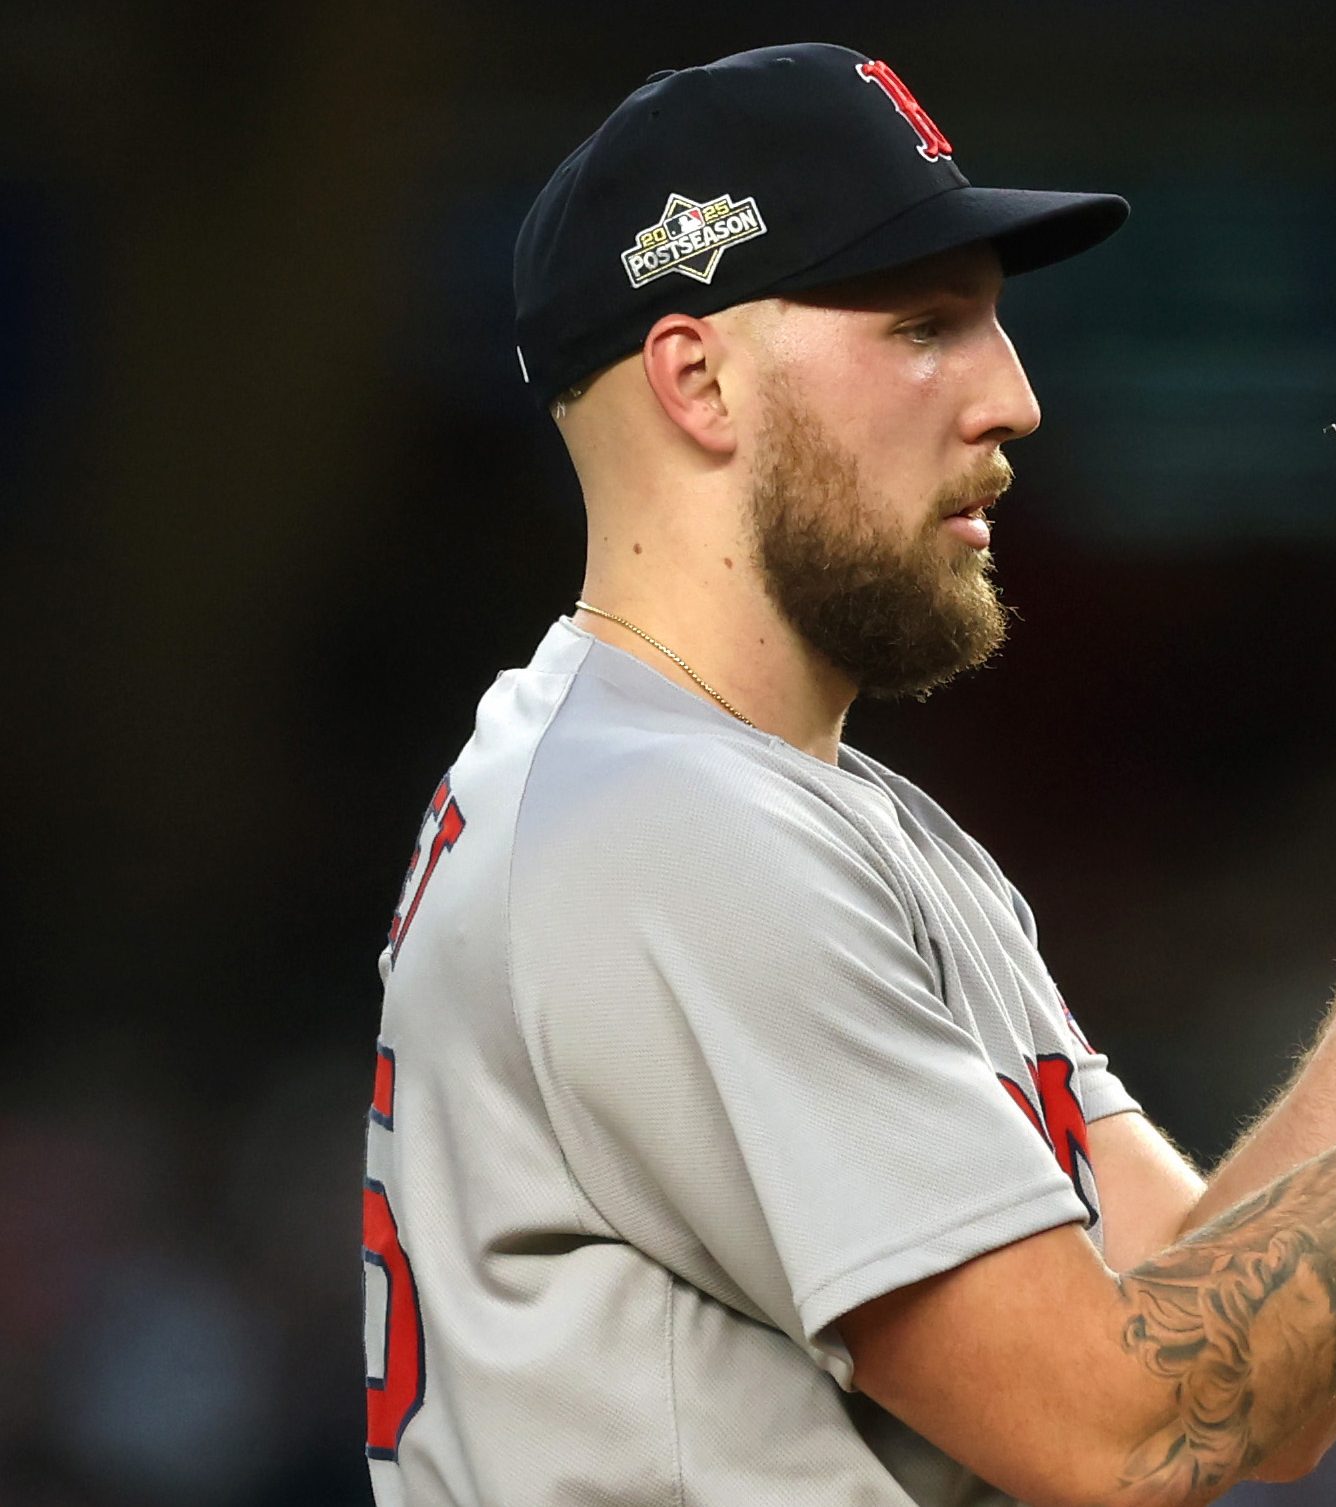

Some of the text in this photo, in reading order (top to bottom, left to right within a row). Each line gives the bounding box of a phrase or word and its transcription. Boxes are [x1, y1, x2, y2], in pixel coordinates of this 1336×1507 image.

[627, 209, 759, 278] POSTSEASON
[640, 200, 730, 247] 20 25
